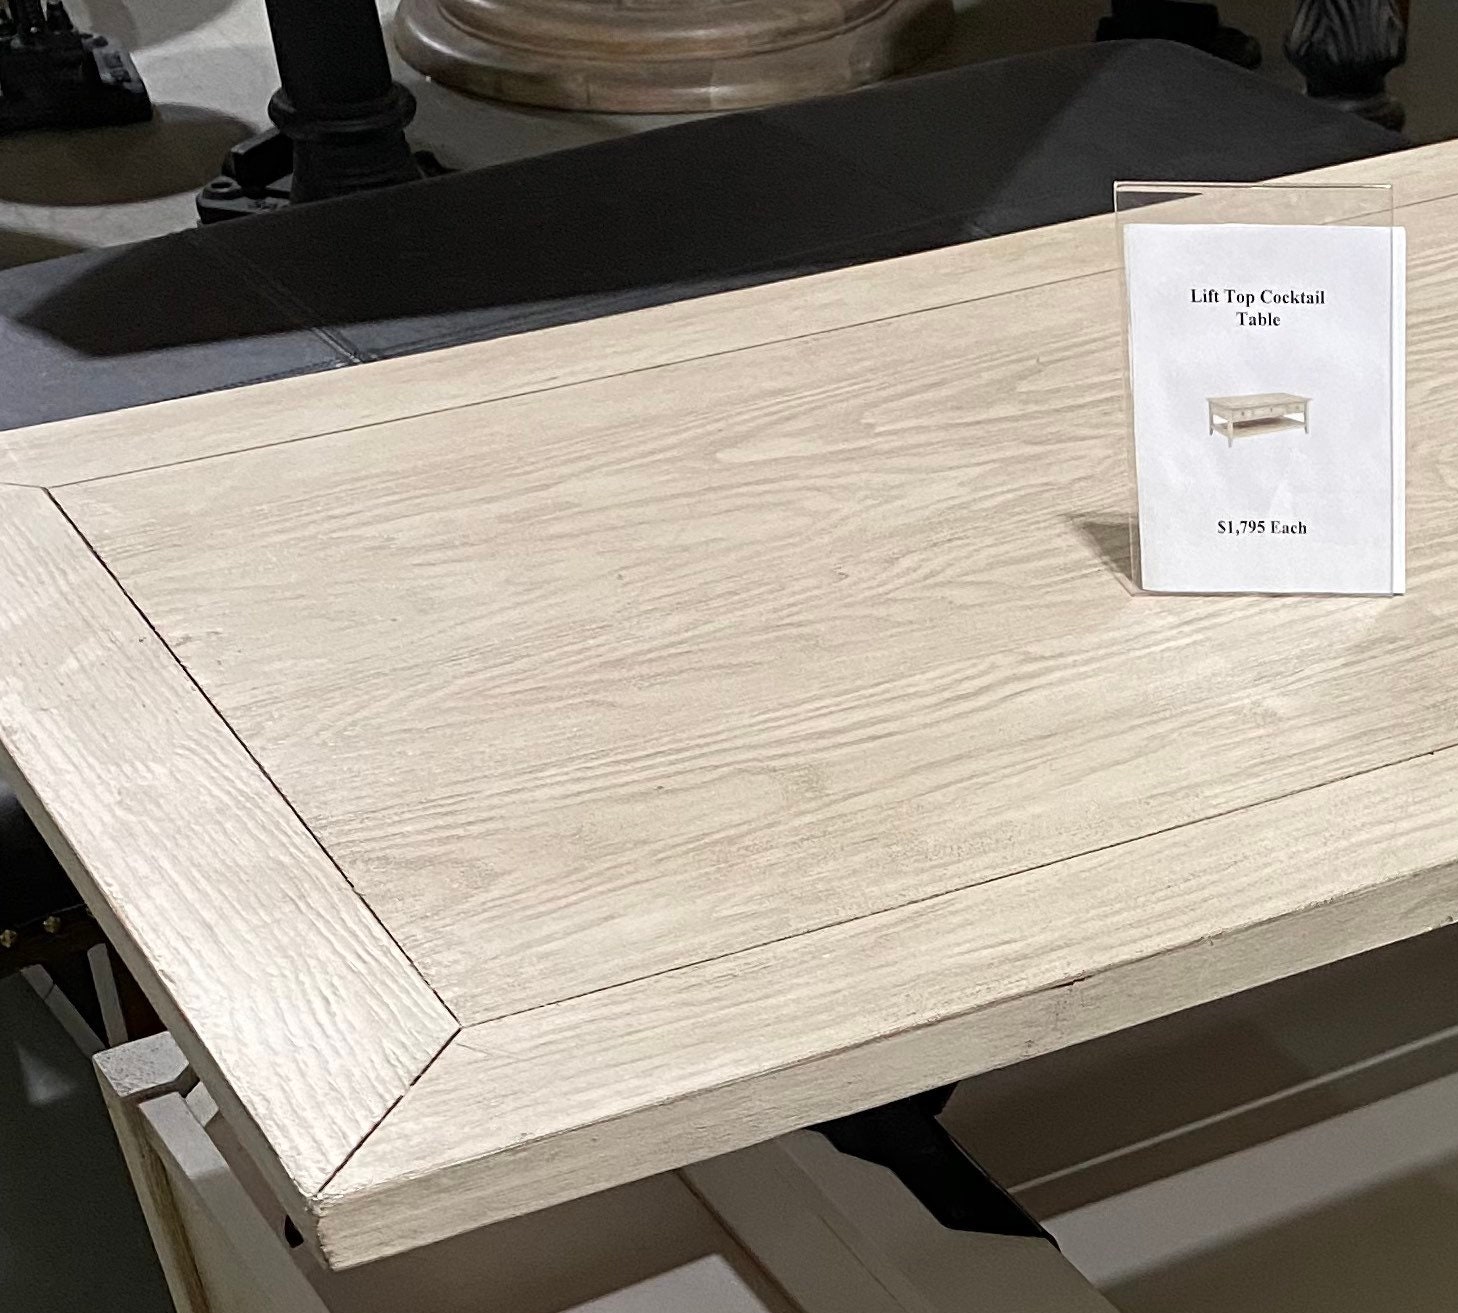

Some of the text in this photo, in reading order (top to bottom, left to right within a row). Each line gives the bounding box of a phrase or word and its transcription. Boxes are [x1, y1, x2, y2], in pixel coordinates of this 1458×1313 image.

[1190, 288, 1325, 307] Lift Top Cocktail
[1236, 311, 1281, 327] Table
[1217, 520, 1307, 537] $1,795 Each
